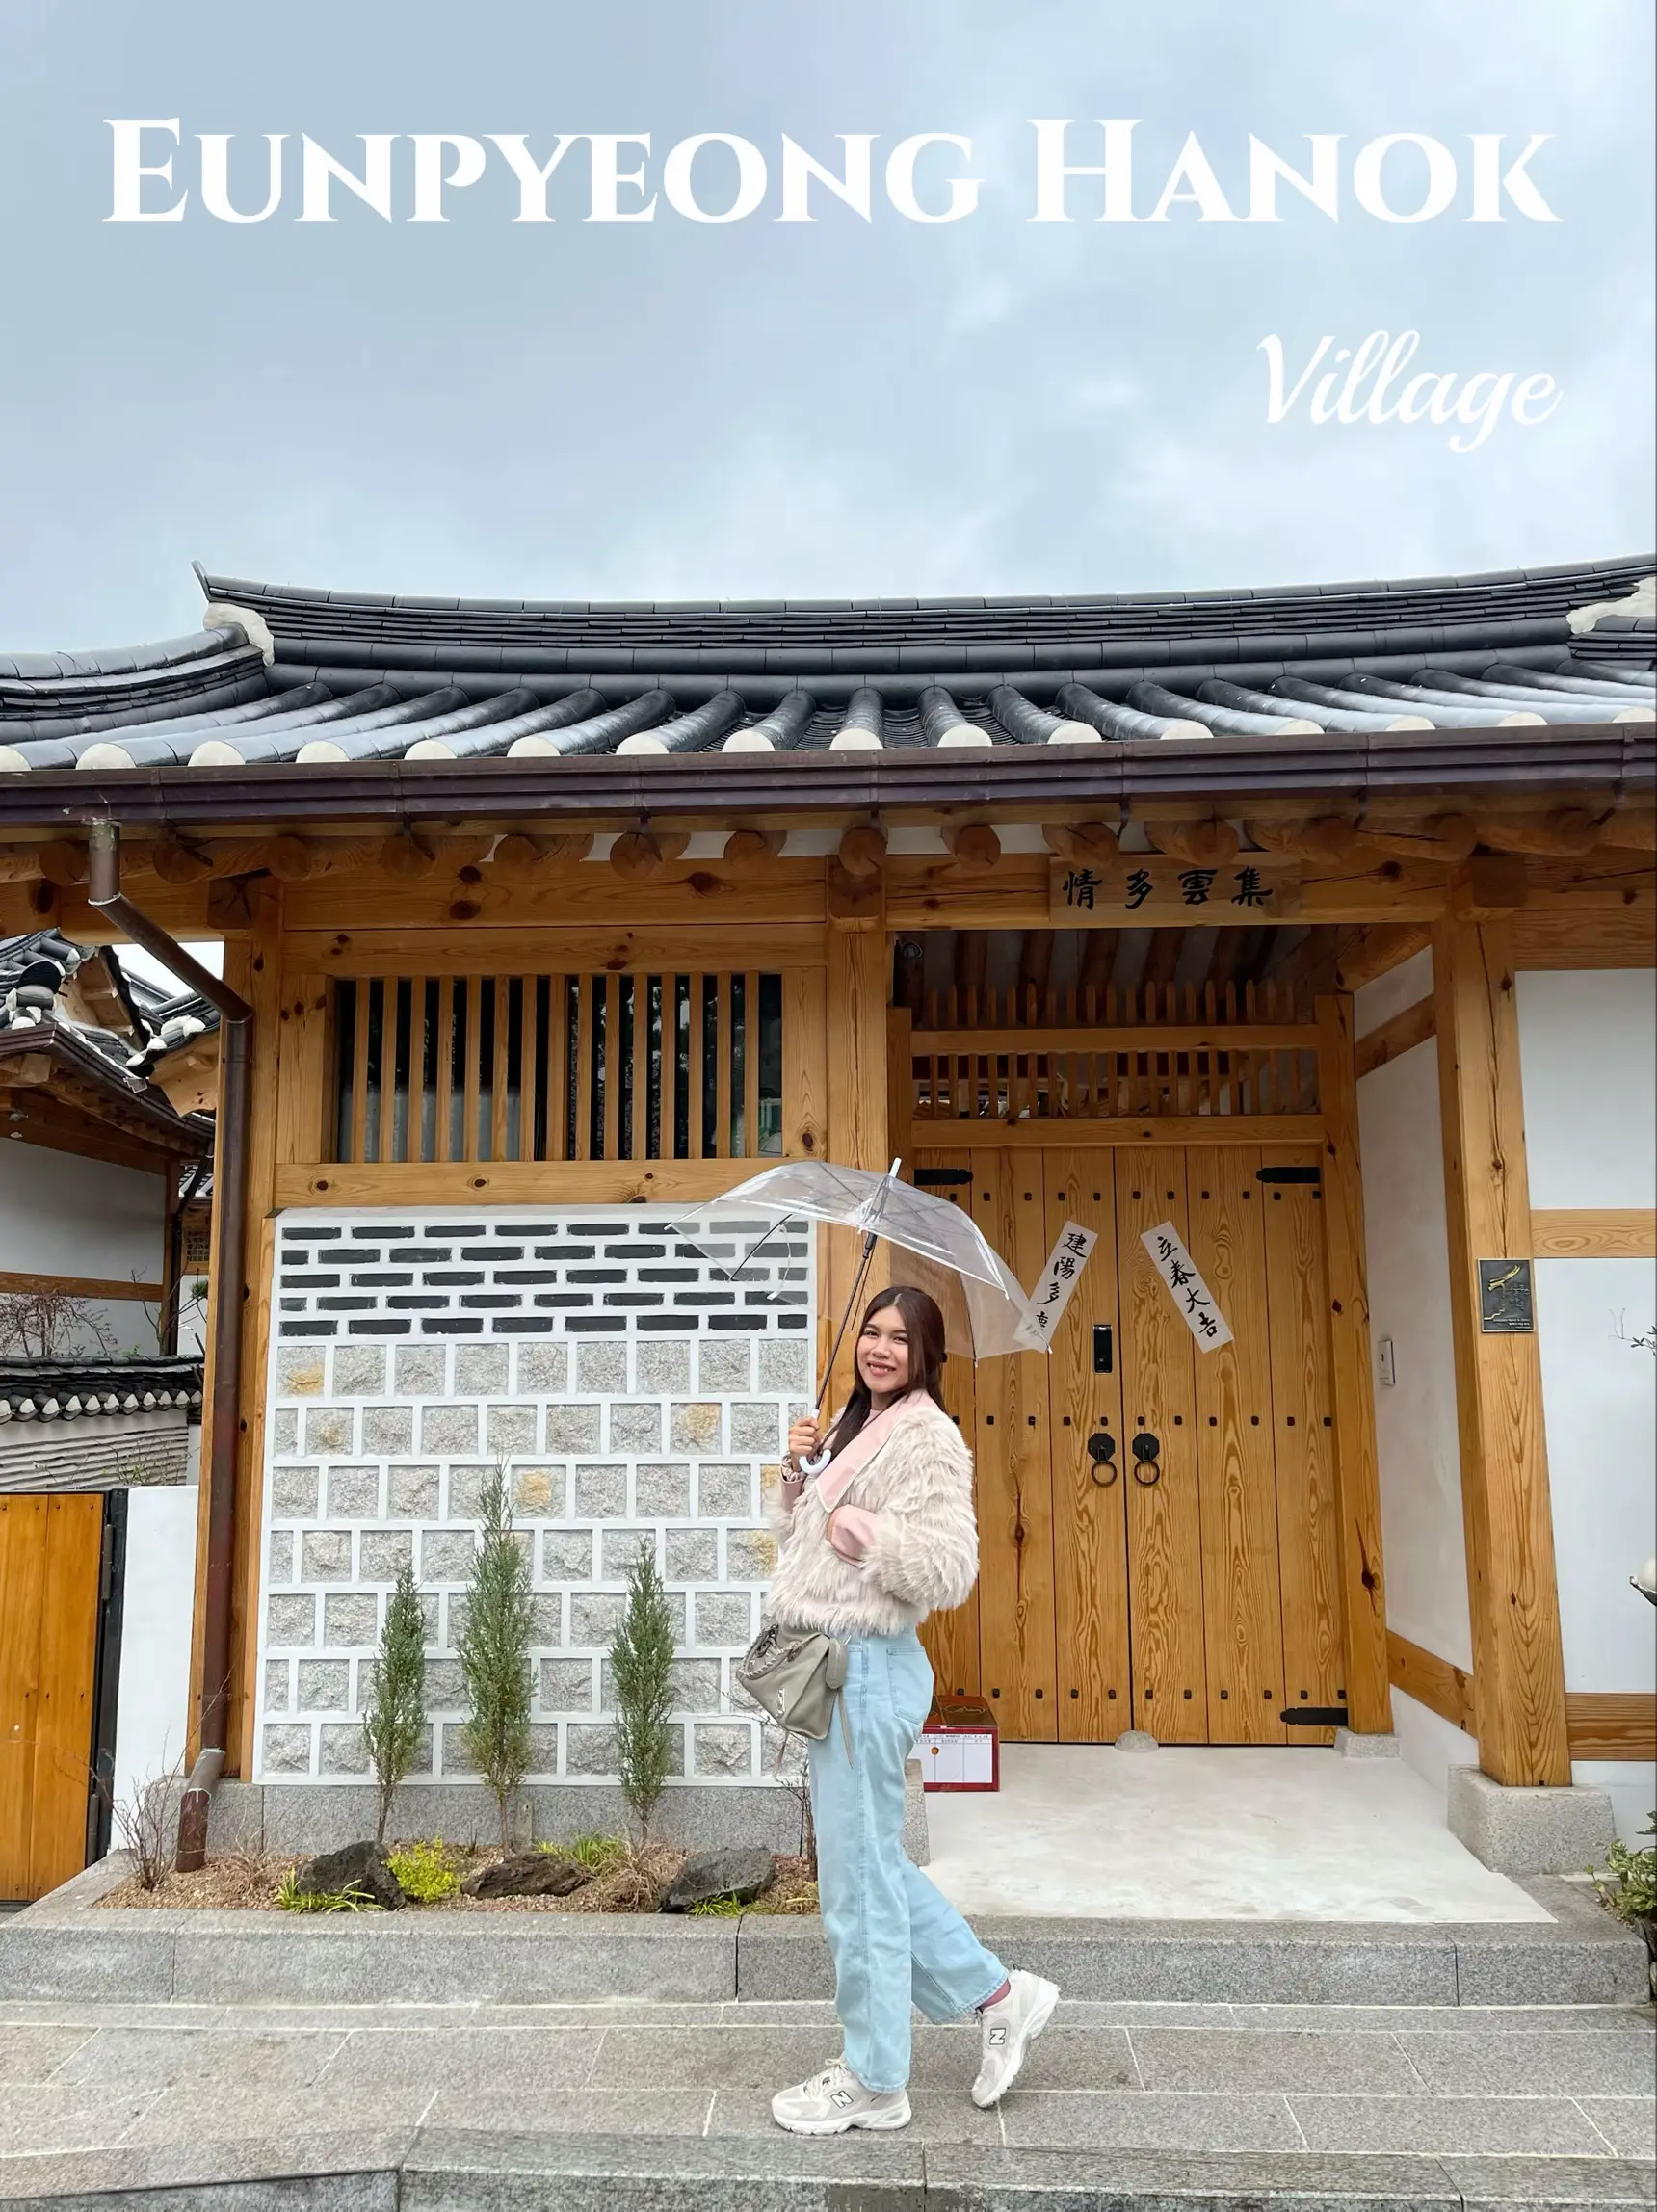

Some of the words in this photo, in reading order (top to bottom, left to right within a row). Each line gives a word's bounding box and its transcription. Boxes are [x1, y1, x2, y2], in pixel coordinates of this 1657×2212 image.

[1156, 1236, 1218, 1337] 立春大吉
[830, 2090, 855, 2109] N
